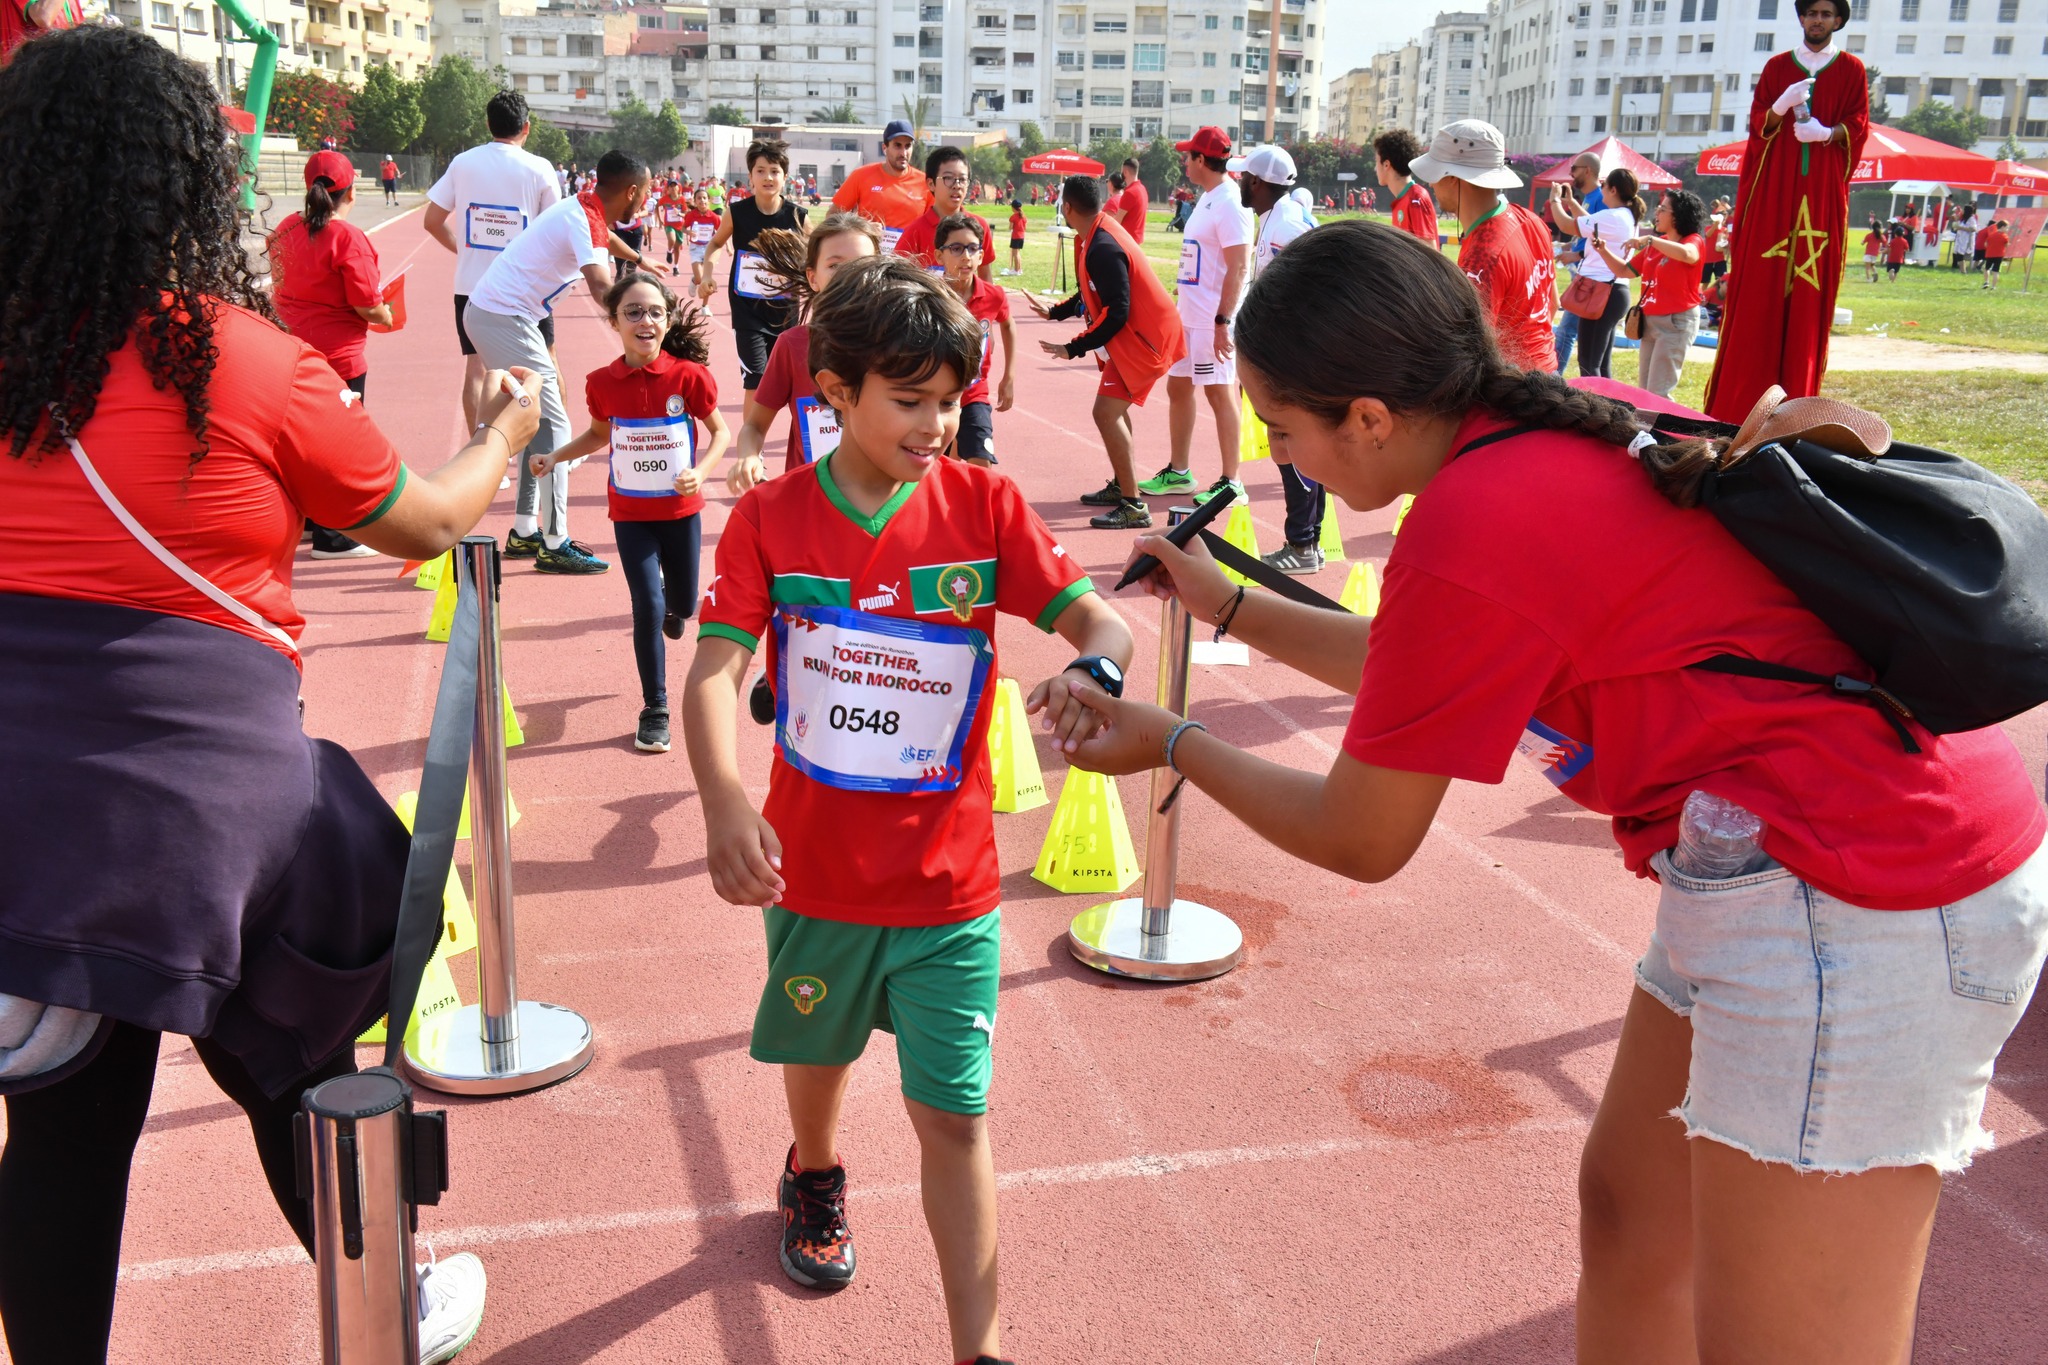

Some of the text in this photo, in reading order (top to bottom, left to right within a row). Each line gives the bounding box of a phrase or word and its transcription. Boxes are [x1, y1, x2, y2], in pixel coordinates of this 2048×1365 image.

[486, 228, 505, 236] 0095
[819, 426, 839, 434] RUN
[626, 434, 669, 443] TOGETHER,
[616, 443, 628, 451] RUN
[646, 441, 684, 451] MOROCCO
[633, 460, 667, 472] 0590
[858, 593, 894, 612] PUMA
[832, 644, 921, 675] TOGETHER,
[803, 656, 953, 695] RUN FOR MOROCCO
[829, 705, 900, 735] 0548
[1017, 785, 1042, 797] KIPSTA
[1073, 869, 1113, 877] KIPSTA
[422, 995, 456, 1018] KIPSTA
